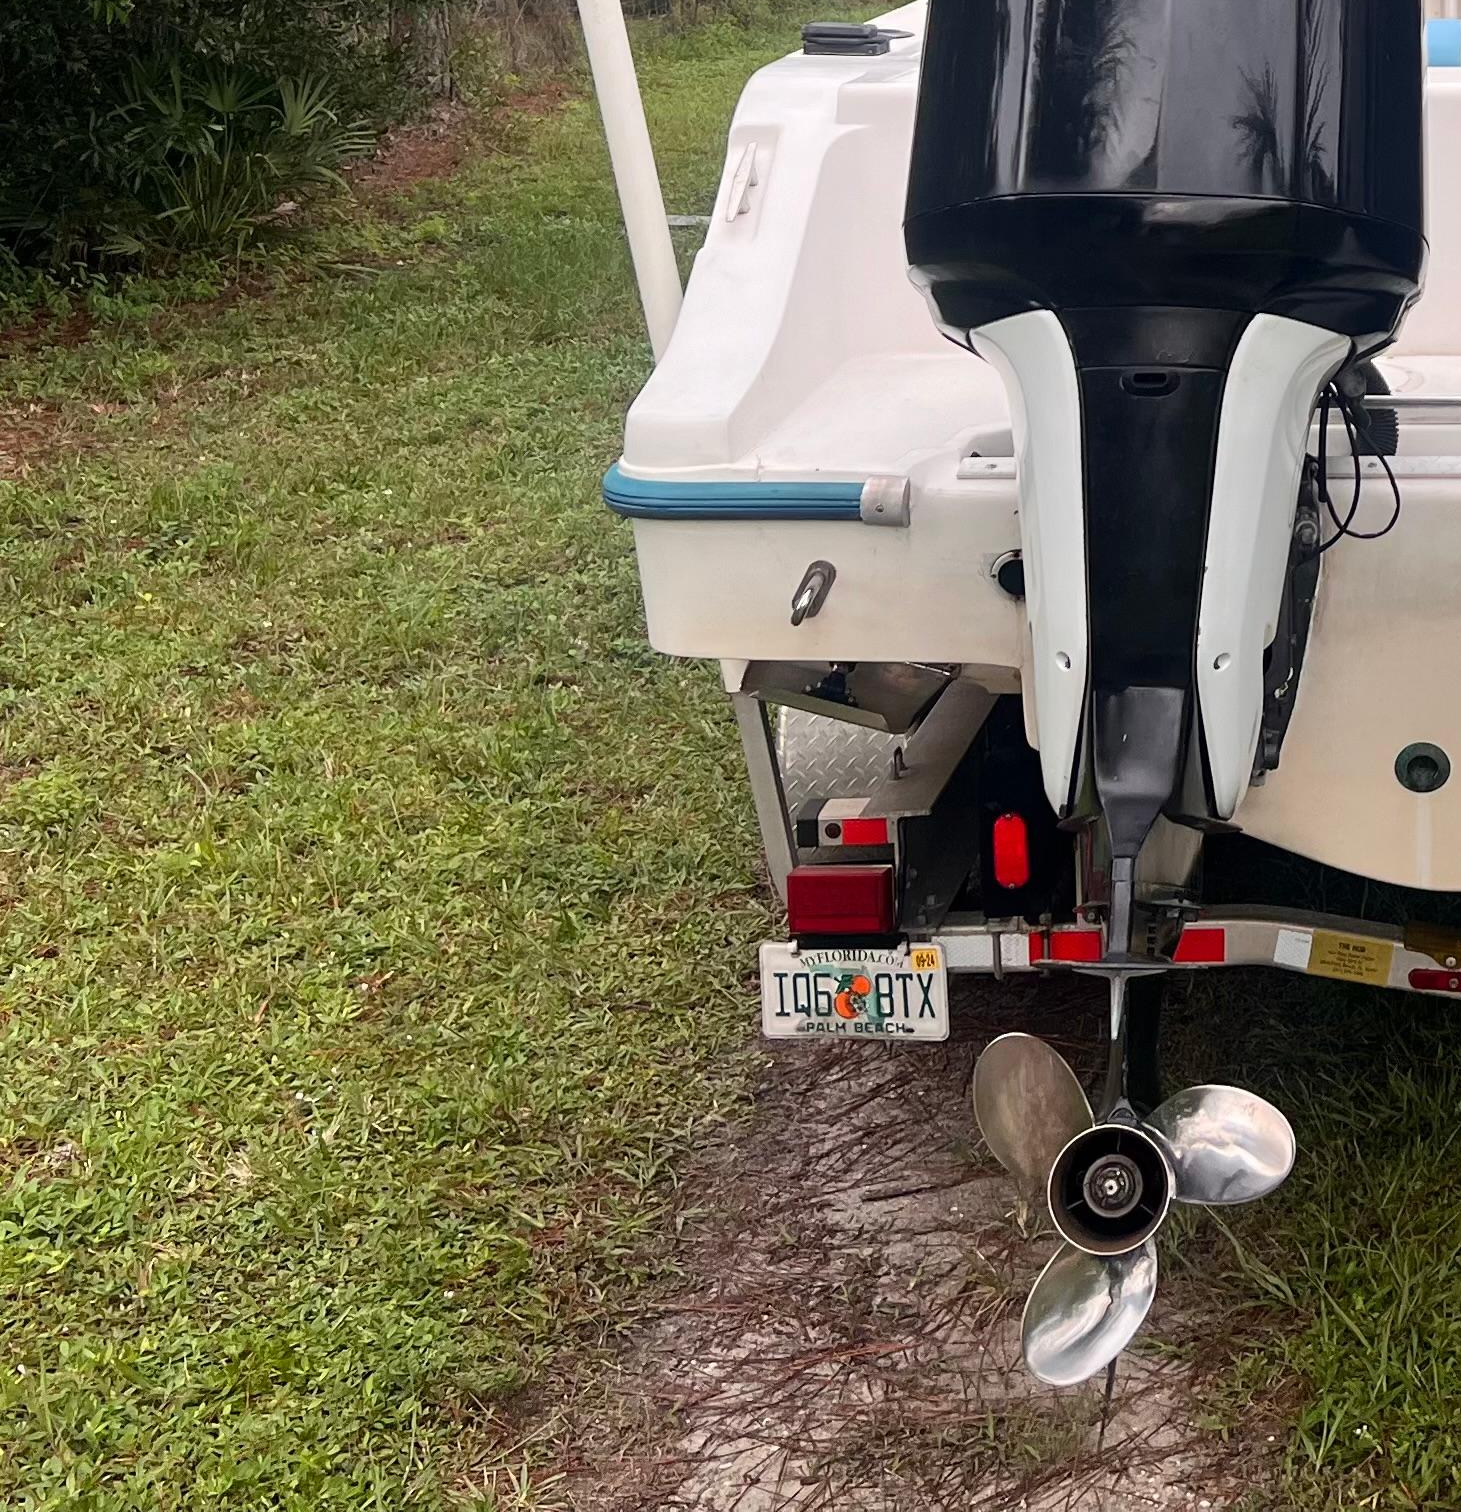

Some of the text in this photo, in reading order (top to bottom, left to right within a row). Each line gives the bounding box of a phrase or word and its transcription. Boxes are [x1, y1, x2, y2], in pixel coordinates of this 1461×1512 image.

[875, 973, 936, 1018] 8TX
[806, 1022, 906, 1033] PALM BEACH
